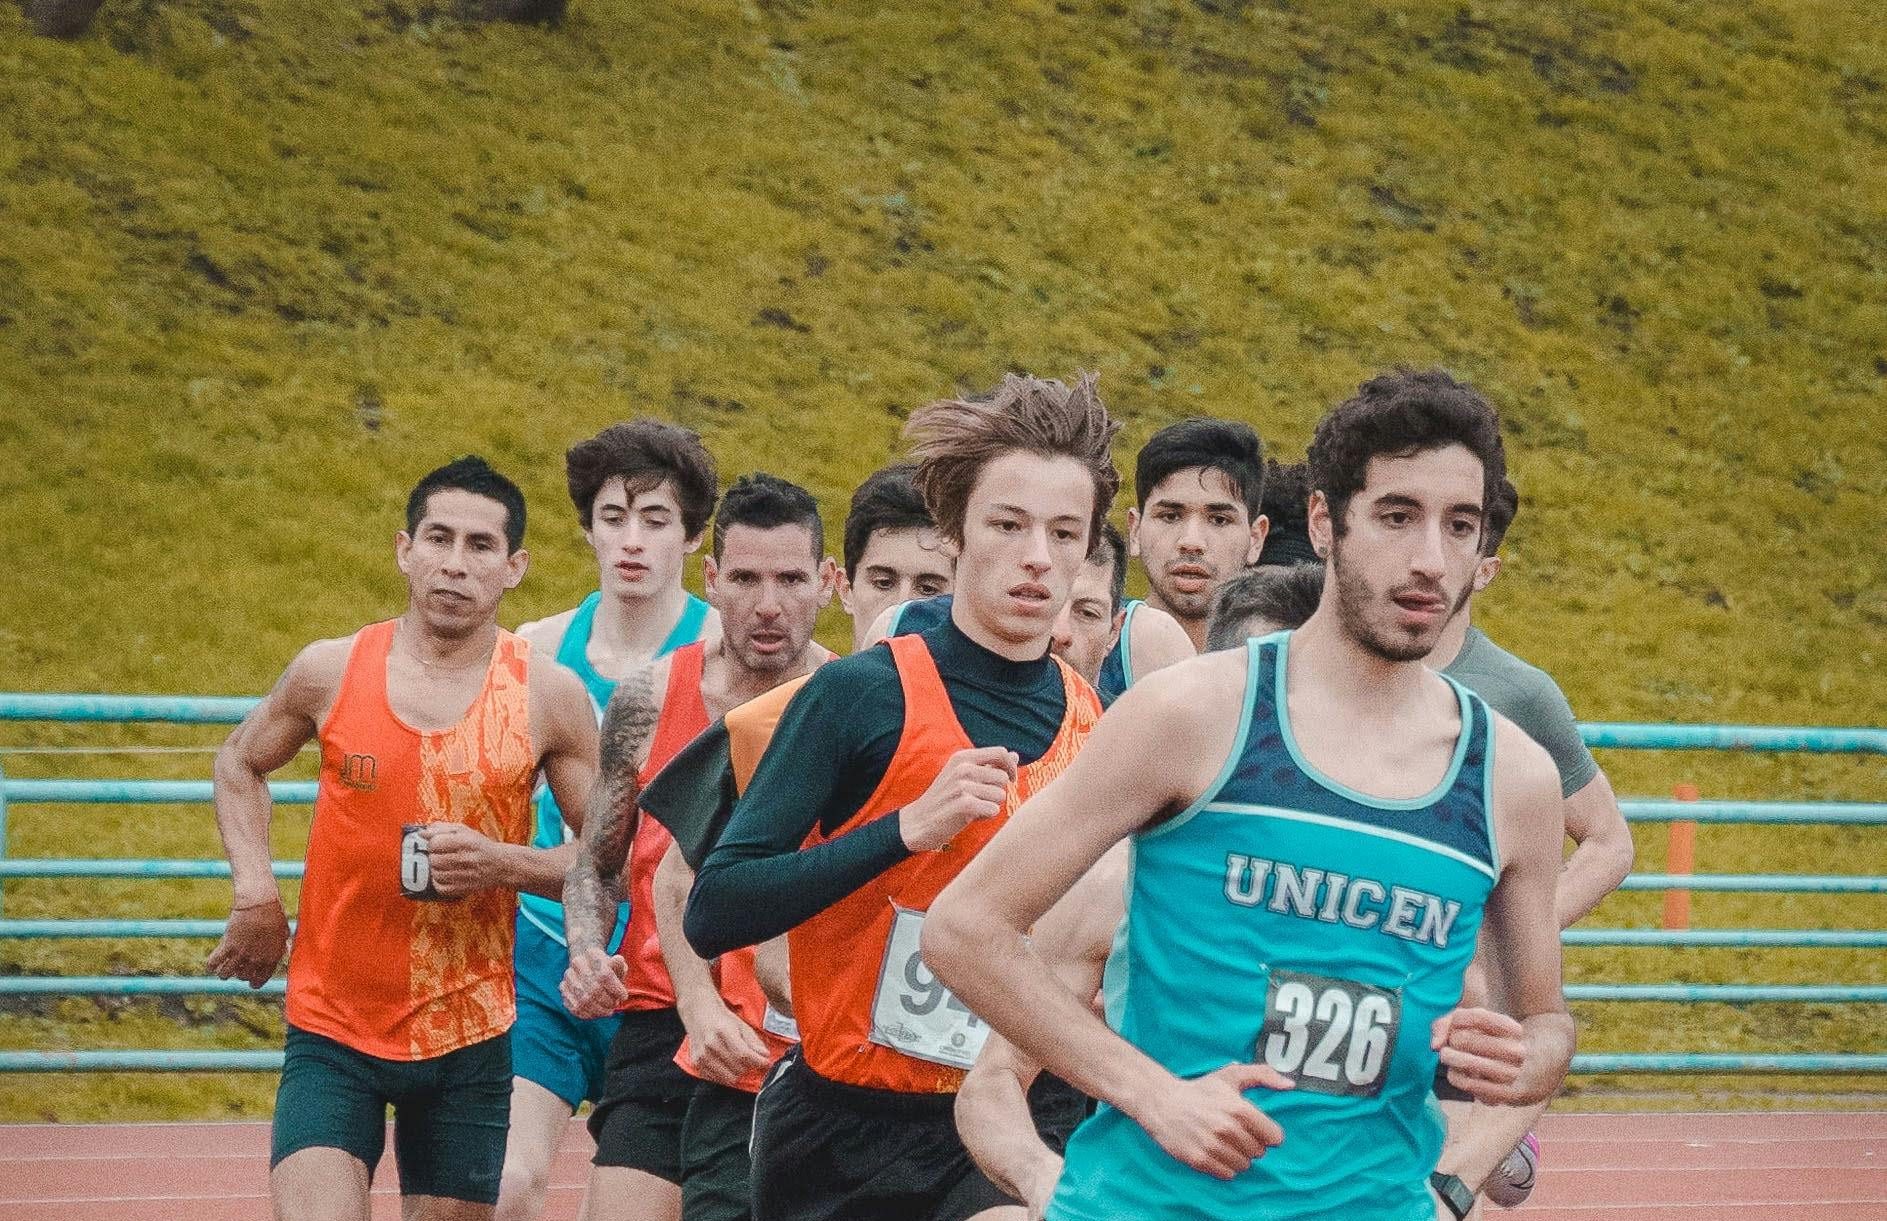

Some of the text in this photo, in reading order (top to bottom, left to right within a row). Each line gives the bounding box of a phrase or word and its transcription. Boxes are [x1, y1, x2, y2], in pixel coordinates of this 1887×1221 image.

[1224, 853, 1461, 948] UNICEN
[900, 951, 978, 1028] 9
[1264, 981, 1392, 1086] 326
